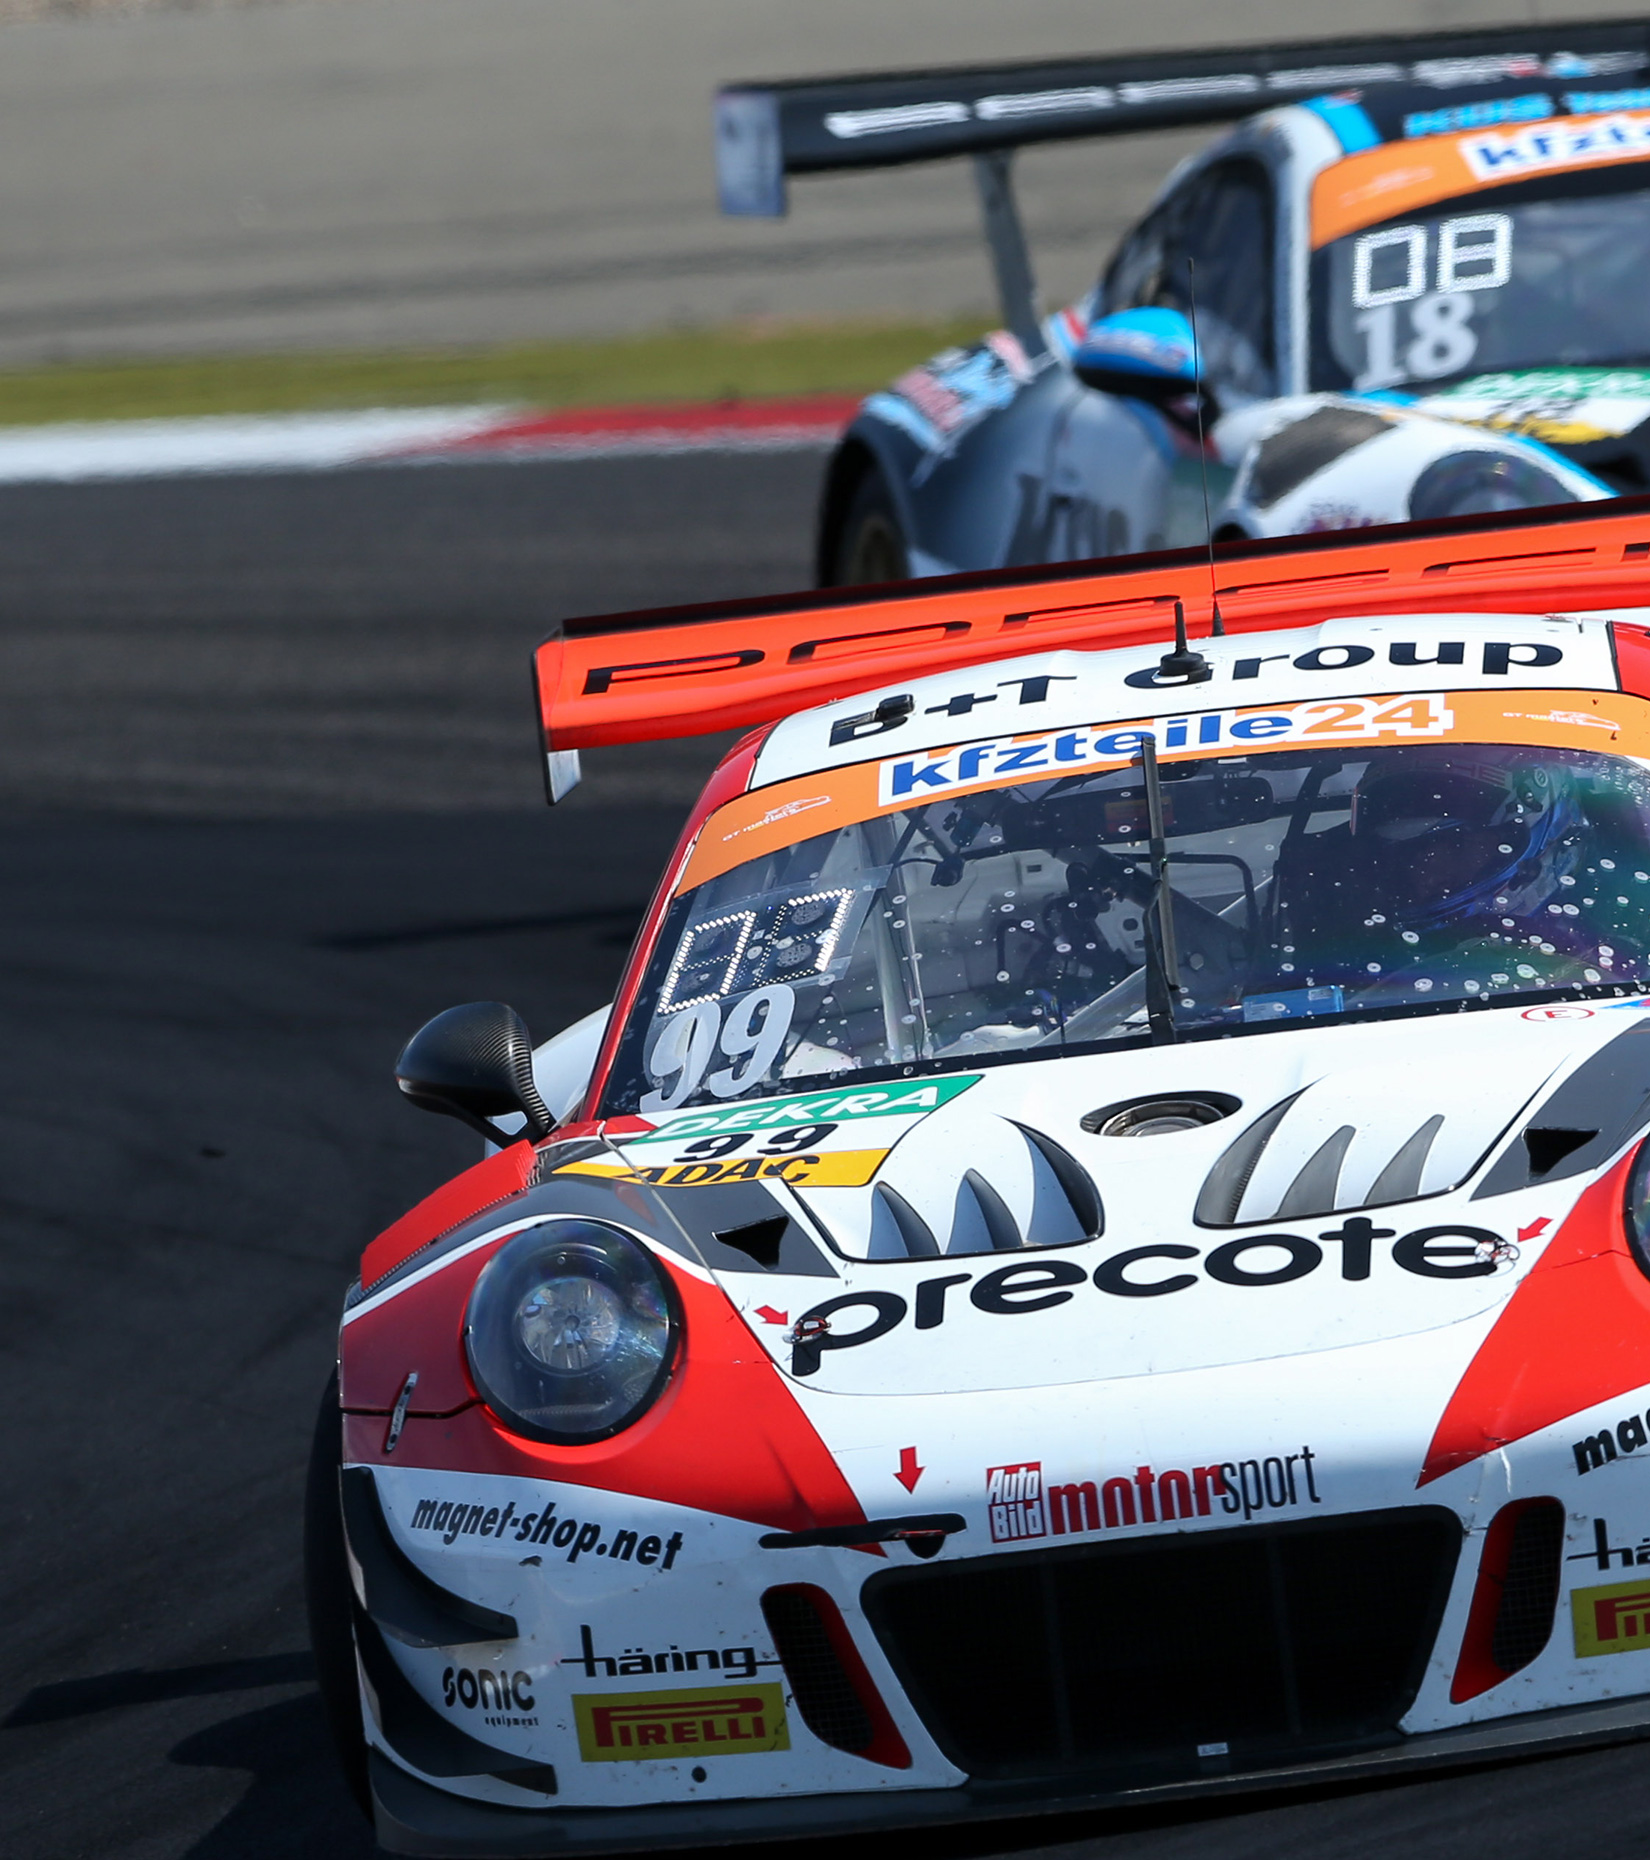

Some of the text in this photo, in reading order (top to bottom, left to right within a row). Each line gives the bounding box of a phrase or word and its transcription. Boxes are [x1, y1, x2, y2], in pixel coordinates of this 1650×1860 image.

[1353, 292, 1479, 392] 18
[829, 642, 1564, 747] B+T Group
[891, 696, 1442, 798] kfzteile24
[640, 984, 796, 1113] 99
[648, 1085, 938, 1139] DEKRA
[612, 1154, 820, 1184] ADAC
[673, 1122, 838, 1163] 99
[790, 1217, 1512, 1377] precote
[988, 1466, 1040, 1504] Auto
[1047, 1445, 1321, 1536] motorsport
[410, 1498, 683, 1570] magnet-shop.net
[992, 1500, 1044, 1541] Bild
[560, 1624, 783, 1679] häring
[485, 1716, 539, 1727] equipment
[591, 1696, 768, 1748] PIRELLI
